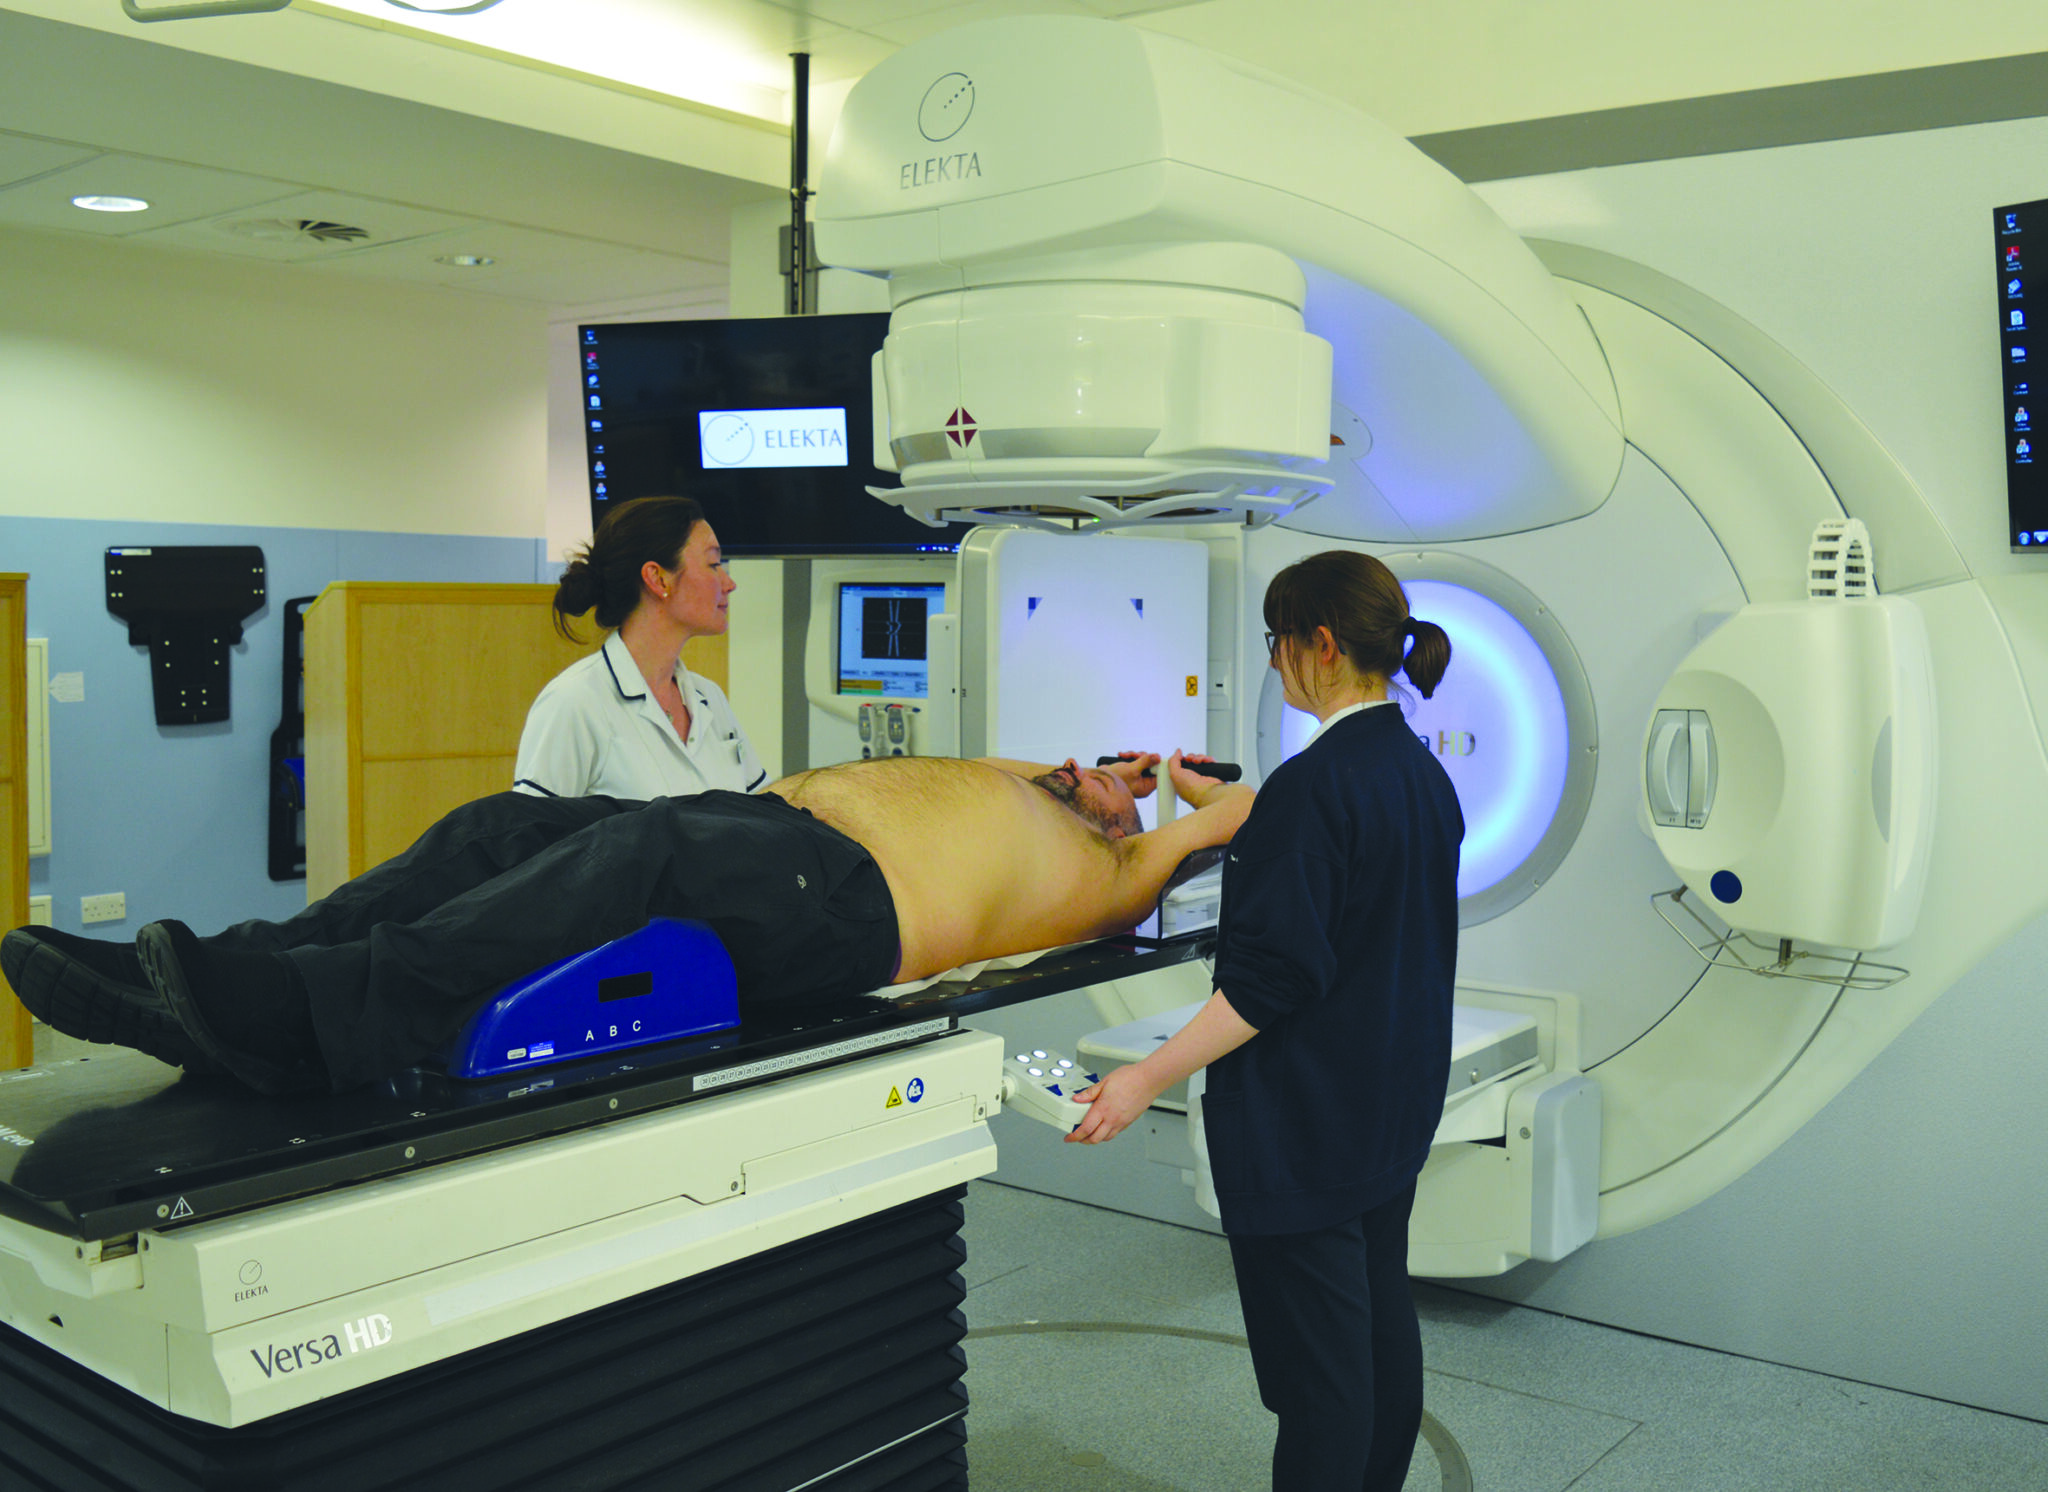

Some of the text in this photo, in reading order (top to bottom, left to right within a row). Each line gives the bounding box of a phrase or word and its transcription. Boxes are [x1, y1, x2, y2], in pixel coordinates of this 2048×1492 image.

[901, 152, 981, 190] ELEKTA
[765, 428, 842, 449] ELEKTA
[1438, 730, 1476, 756] HD
[585, 1019, 641, 1041] A B C
[234, 1284, 269, 1302] ELEKTA
[250, 1312, 392, 1379] Versa HD
